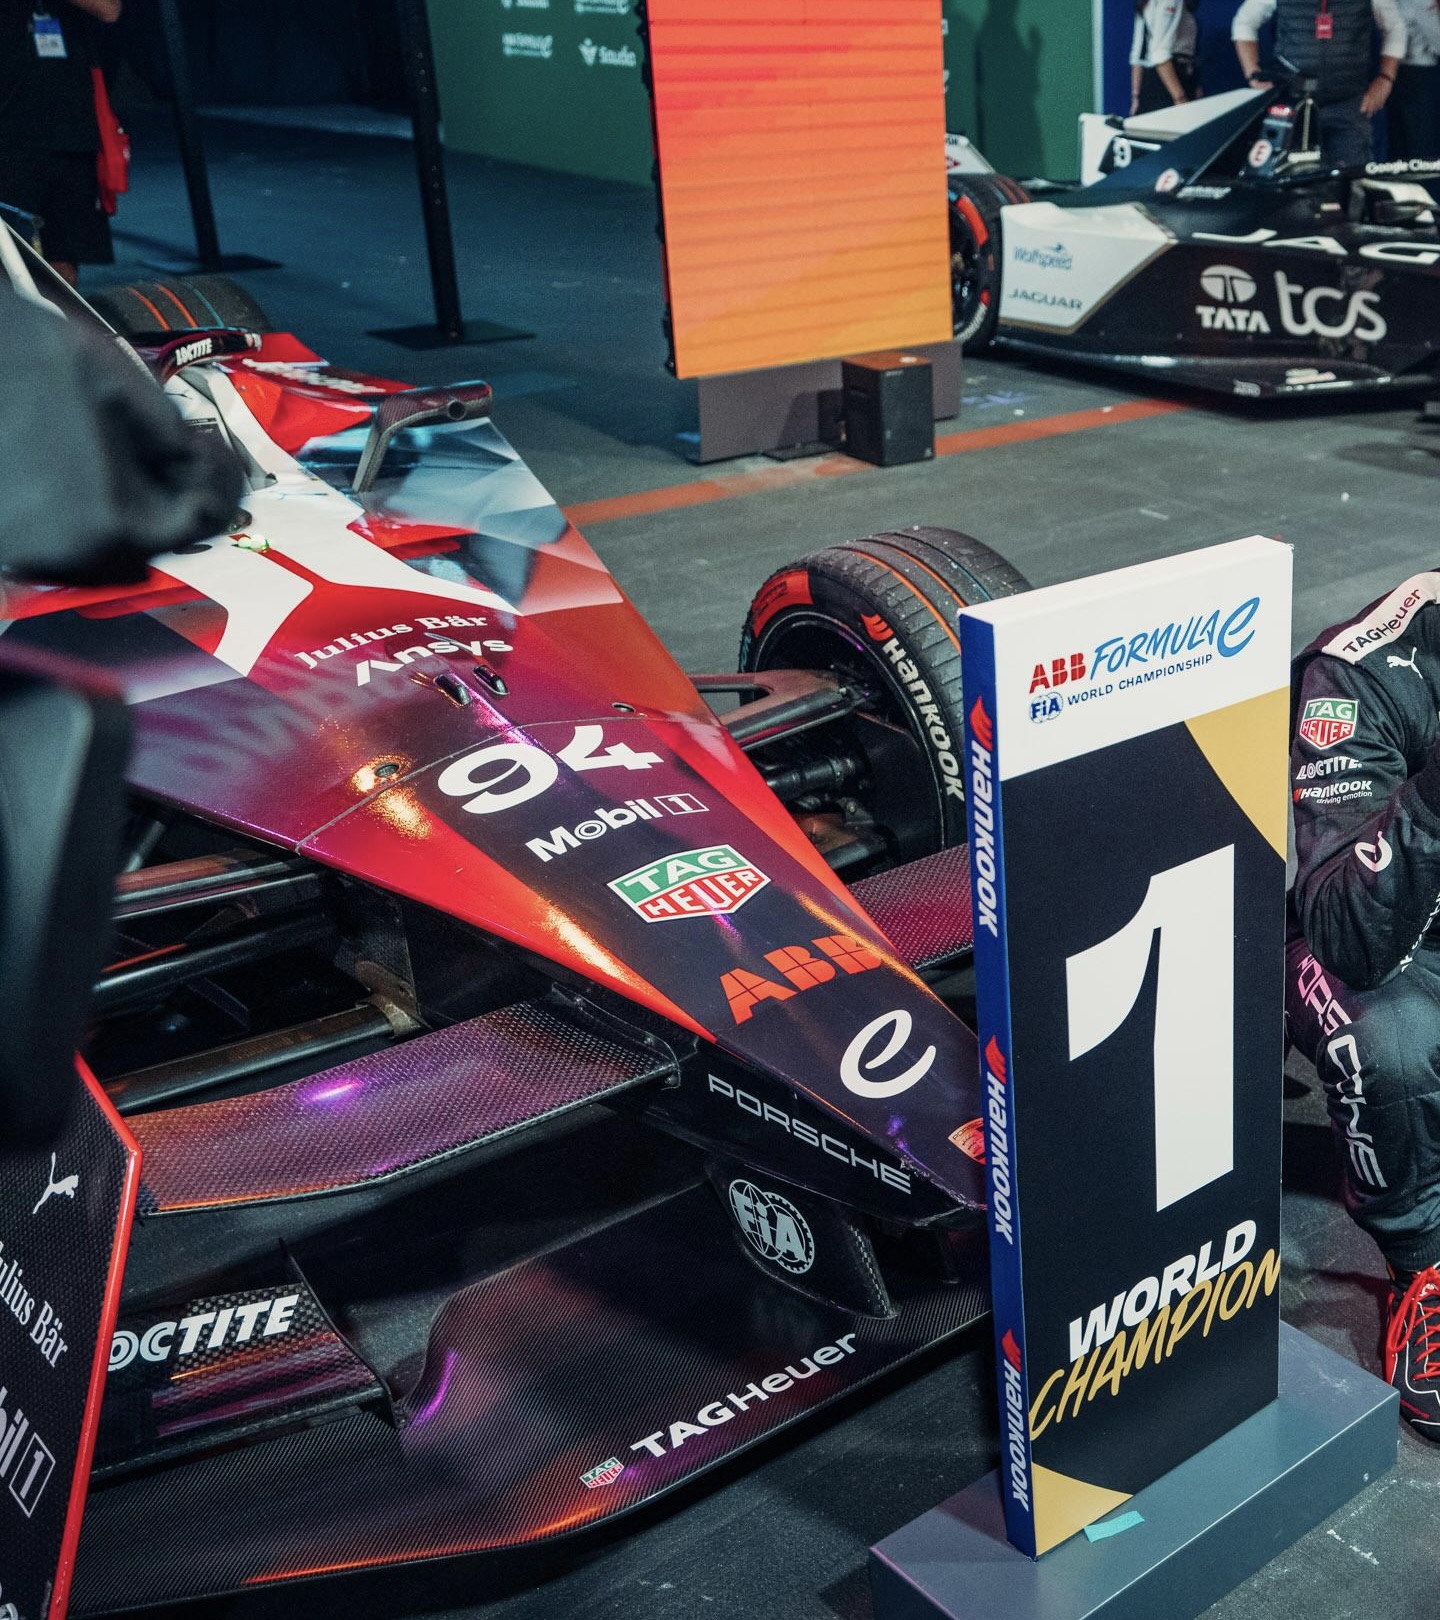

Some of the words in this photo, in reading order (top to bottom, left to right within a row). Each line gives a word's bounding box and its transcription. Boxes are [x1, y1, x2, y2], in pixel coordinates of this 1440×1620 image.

[1365, 161, 1408, 175] Google
[1008, 289, 1082, 309] JAGUAR
[1196, 306, 1271, 334] TATA
[1274, 270, 1388, 342] tcs
[176, 338, 213, 366] LOCTITE
[294, 622, 414, 669] Julius
[415, 615, 488, 630] Bär
[355, 639, 514, 687] Ansys
[1029, 652, 1087, 694] ABB
[1090, 609, 1221, 681] FORMULA
[1067, 684, 1113, 706] WORLD
[1118, 653, 1213, 691] CHAMPIONSHIP
[1301, 719, 1351, 746] HEUER
[1308, 700, 1354, 719] TAG
[437, 725, 664, 814] 94
[1316, 795, 1342, 805] driving
[1342, 790, 1373, 801] emotion
[525, 798, 661, 863] Mobil
[623, 850, 738, 893] TAG
[638, 868, 763, 920] HEUER
[719, 934, 883, 1025] ABB
[1066, 843, 1235, 1213] 1
[707, 1073, 913, 1196] PORSCHE
[1069, 1219, 1257, 1364] WORLD
[31, 1299, 68, 1368] Bär
[107, 1293, 300, 1372] OCTITE
[1028, 1248, 1281, 1442] CHAMPION
[583, 1460, 616, 1479] TAG
